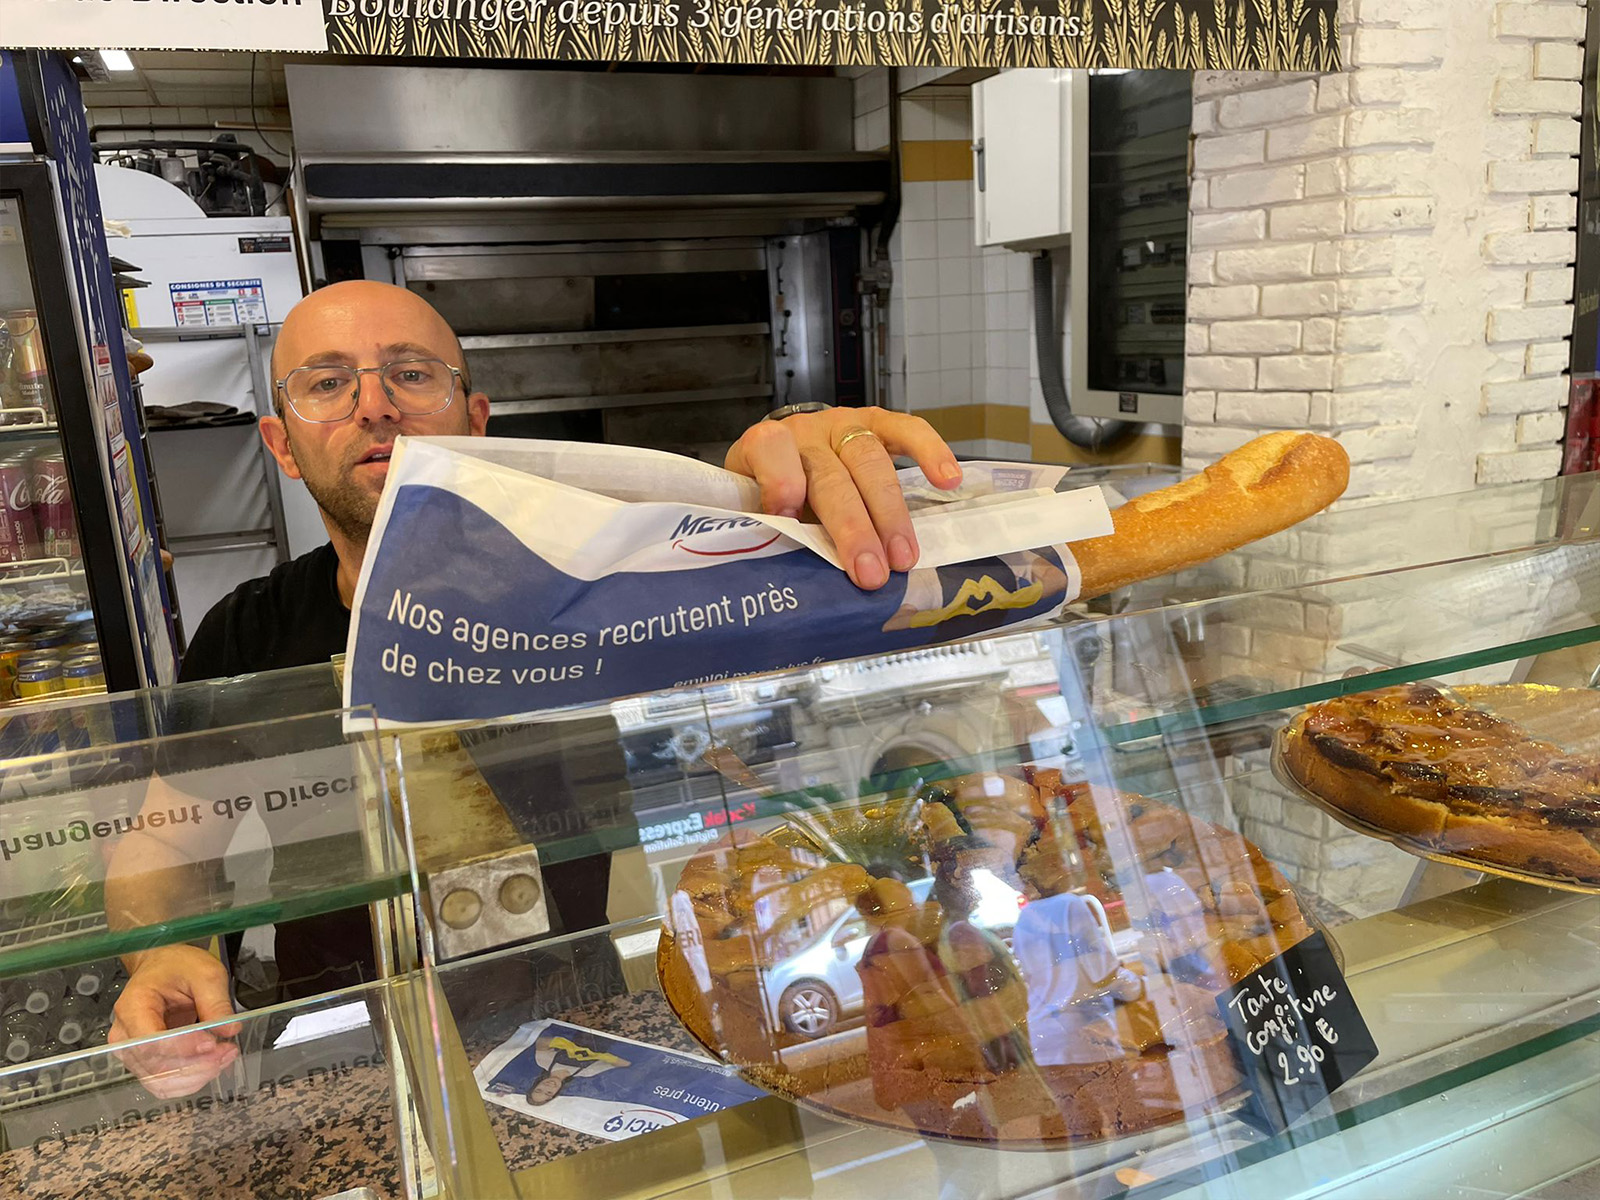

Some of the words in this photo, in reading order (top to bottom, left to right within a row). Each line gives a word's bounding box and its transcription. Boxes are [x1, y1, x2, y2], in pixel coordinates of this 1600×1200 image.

[328, 0, 547, 31] Boulanger
[557, 0, 680, 35] depuis
[690, 0, 711, 28] 3
[721, 0, 922, 38] générations
[930, 3, 1086, 37] d'artisans.
[387, 588, 444, 635] Nos
[452, 617, 587, 653] agences
[598, 595, 735, 647] recrutent
[740, 583, 799, 627] près
[381, 643, 417, 677] de
[428, 657, 501, 684] chez
[511, 664, 584, 685] vous
[1228, 974, 1288, 1023] Tarte
[1277, 1044, 1325, 1086] 2.90
[653, 1085, 686, 1102] près
